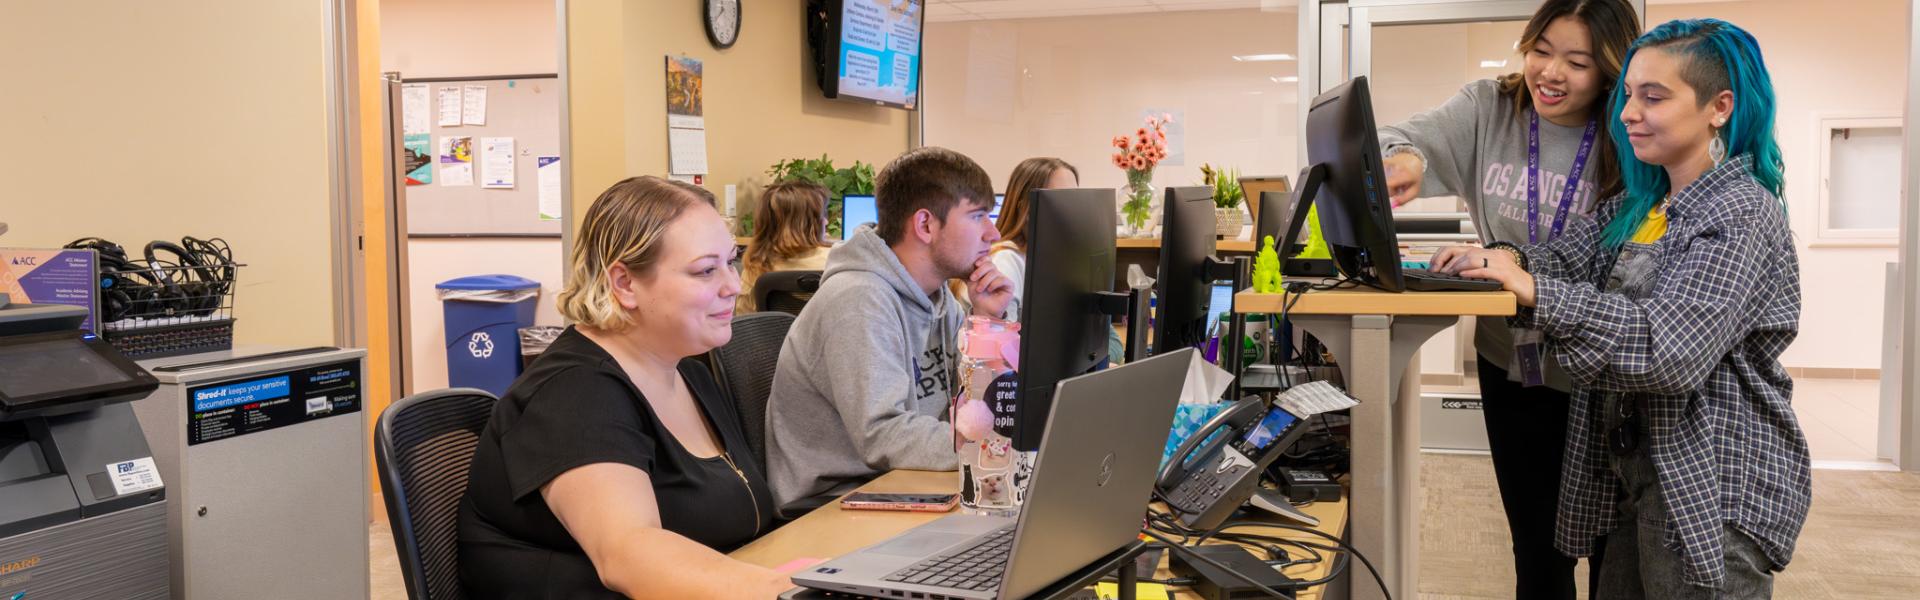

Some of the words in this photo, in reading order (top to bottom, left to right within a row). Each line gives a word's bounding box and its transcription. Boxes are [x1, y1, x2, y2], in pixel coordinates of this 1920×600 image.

[1571, 168, 1582, 180] ACC
[1482, 162, 1514, 197] OS
[1510, 166, 1595, 216] ANGEL
[1498, 202, 1556, 229] CALIOR
[20, 256, 37, 266] ACC
[197, 389, 227, 400] Shred-it
[229, 386, 247, 395] keeps
[248, 384, 261, 393] your
[262, 380, 287, 389] sensitive
[996, 390, 1016, 401] great
[197, 398, 233, 410] documents
[234, 394, 255, 403] secure.
[996, 401, 1003, 413] &
[995, 415, 1014, 428] opin
[117, 462, 134, 473] FBP
[0, 555, 41, 575] HARP
